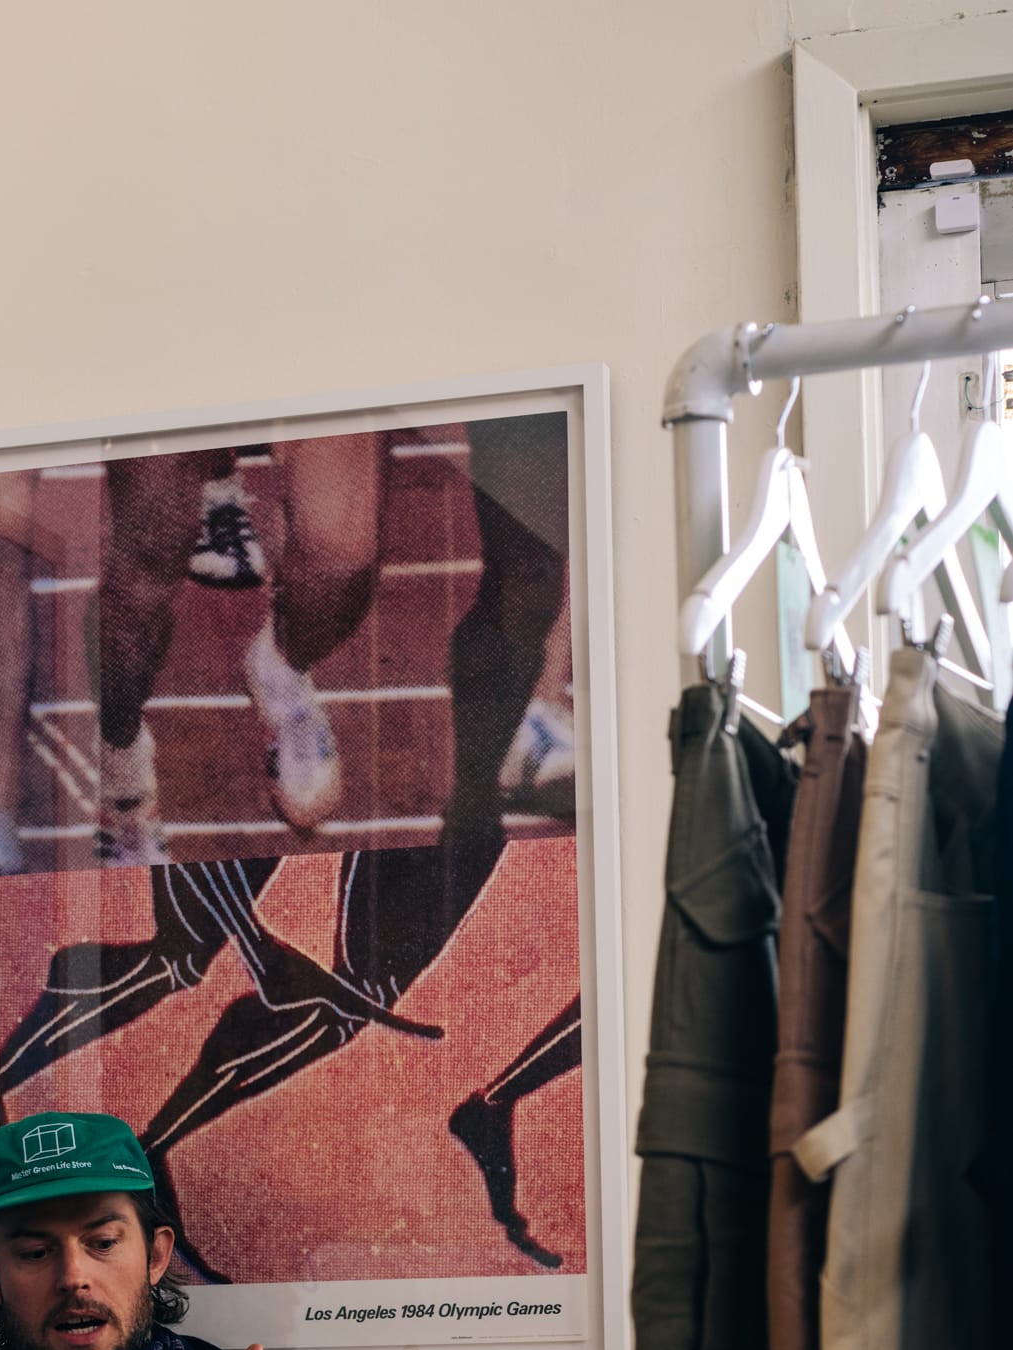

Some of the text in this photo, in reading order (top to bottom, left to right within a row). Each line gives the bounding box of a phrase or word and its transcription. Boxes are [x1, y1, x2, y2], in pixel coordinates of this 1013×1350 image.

[33, 1164, 56, 1174] Green
[56, 1160, 71, 1170] Life
[71, 1160, 92, 1169] Store
[305, 1301, 562, 1323] Los Angeles 1984 Olympic Games
